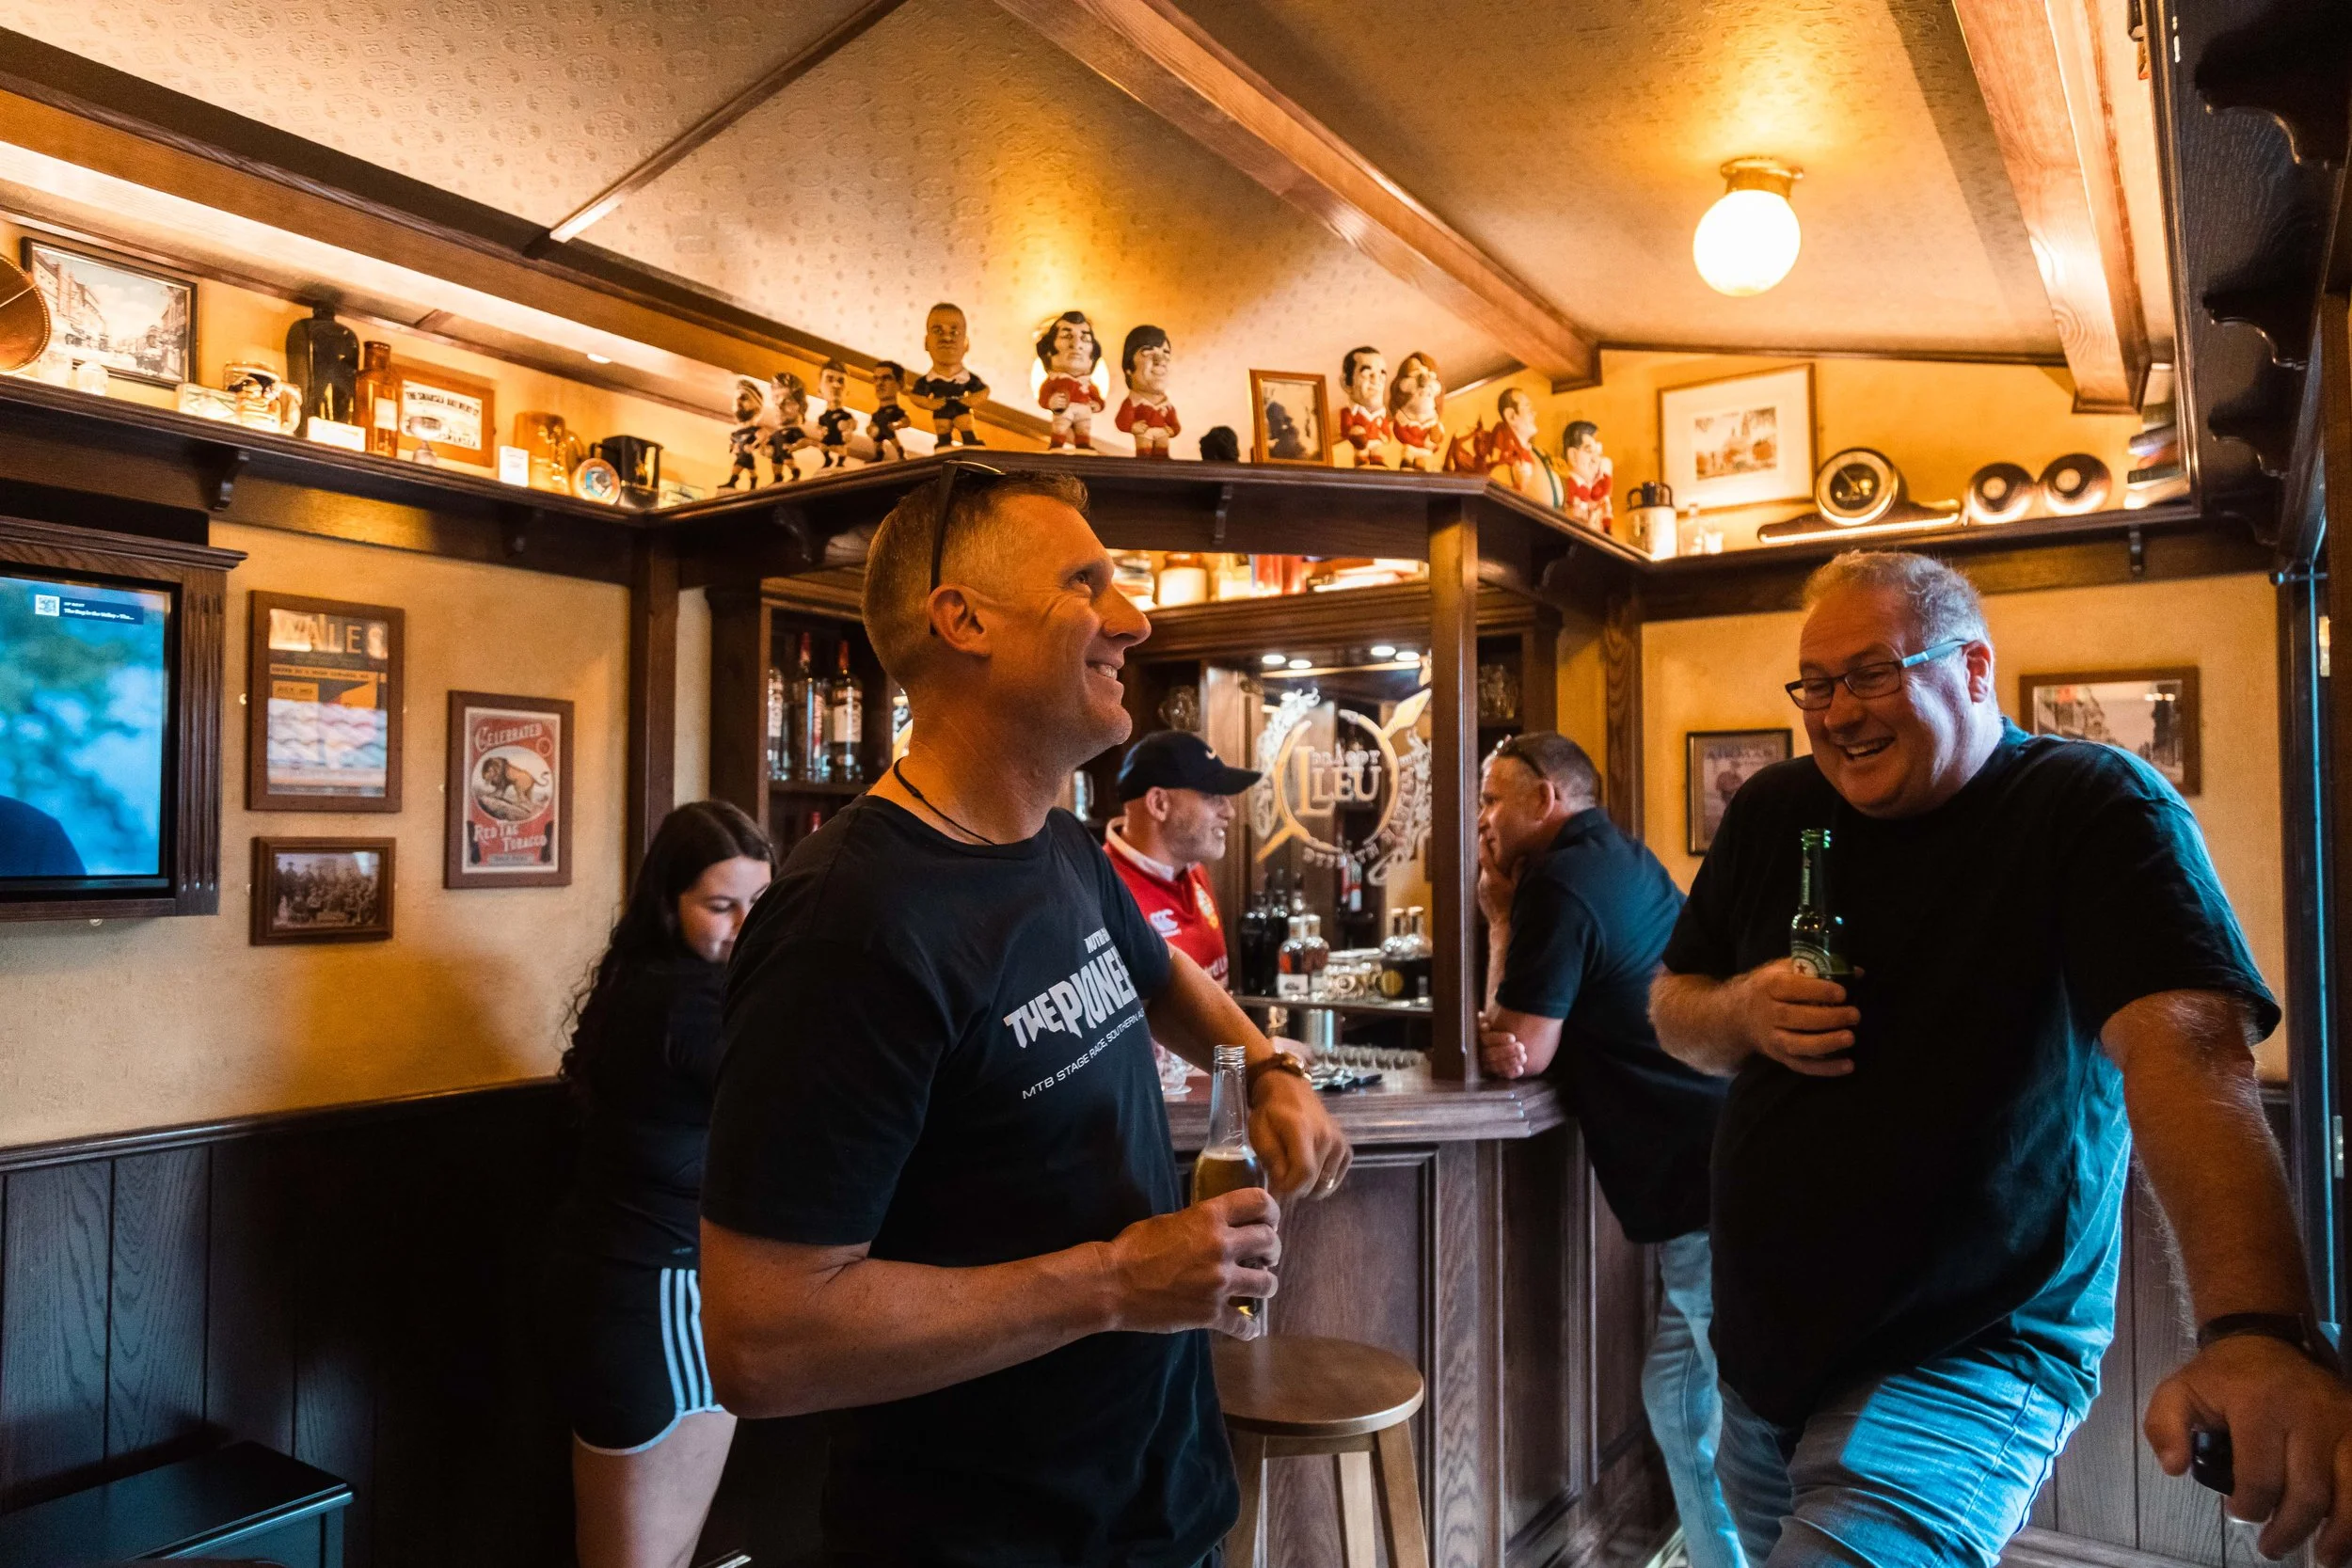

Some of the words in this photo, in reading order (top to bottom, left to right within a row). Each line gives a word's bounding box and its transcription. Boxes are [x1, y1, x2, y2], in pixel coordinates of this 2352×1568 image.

[1022, 1076, 1055, 1100] MTB
[1056, 1053, 1090, 1082] STAGE
[1089, 1037, 1109, 1059] RACE,
[1105, 1014, 1140, 1043] SOUTHERN
